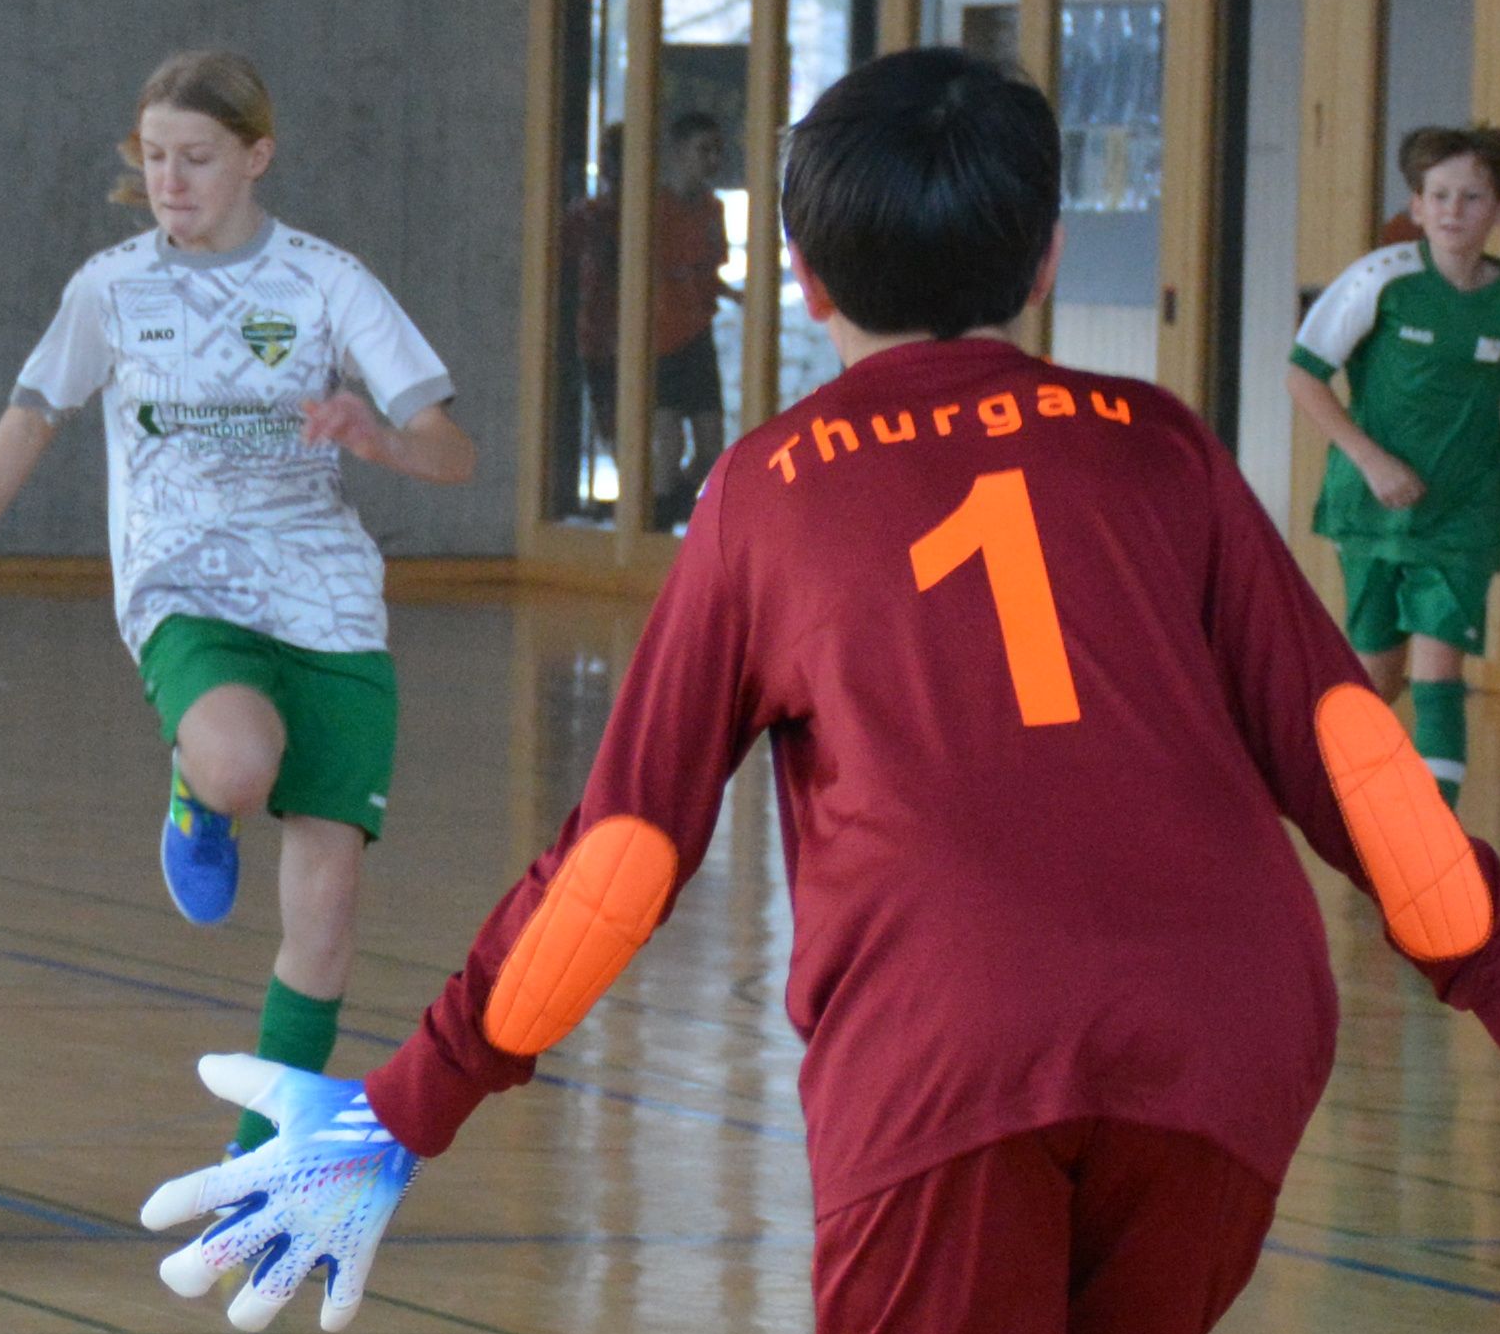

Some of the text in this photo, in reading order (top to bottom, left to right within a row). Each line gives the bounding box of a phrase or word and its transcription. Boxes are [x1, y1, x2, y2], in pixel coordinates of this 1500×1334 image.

[138, 328, 175, 342] JAKO
[767, 383, 1132, 484] Thurgau
[908, 467, 1081, 727] 1
